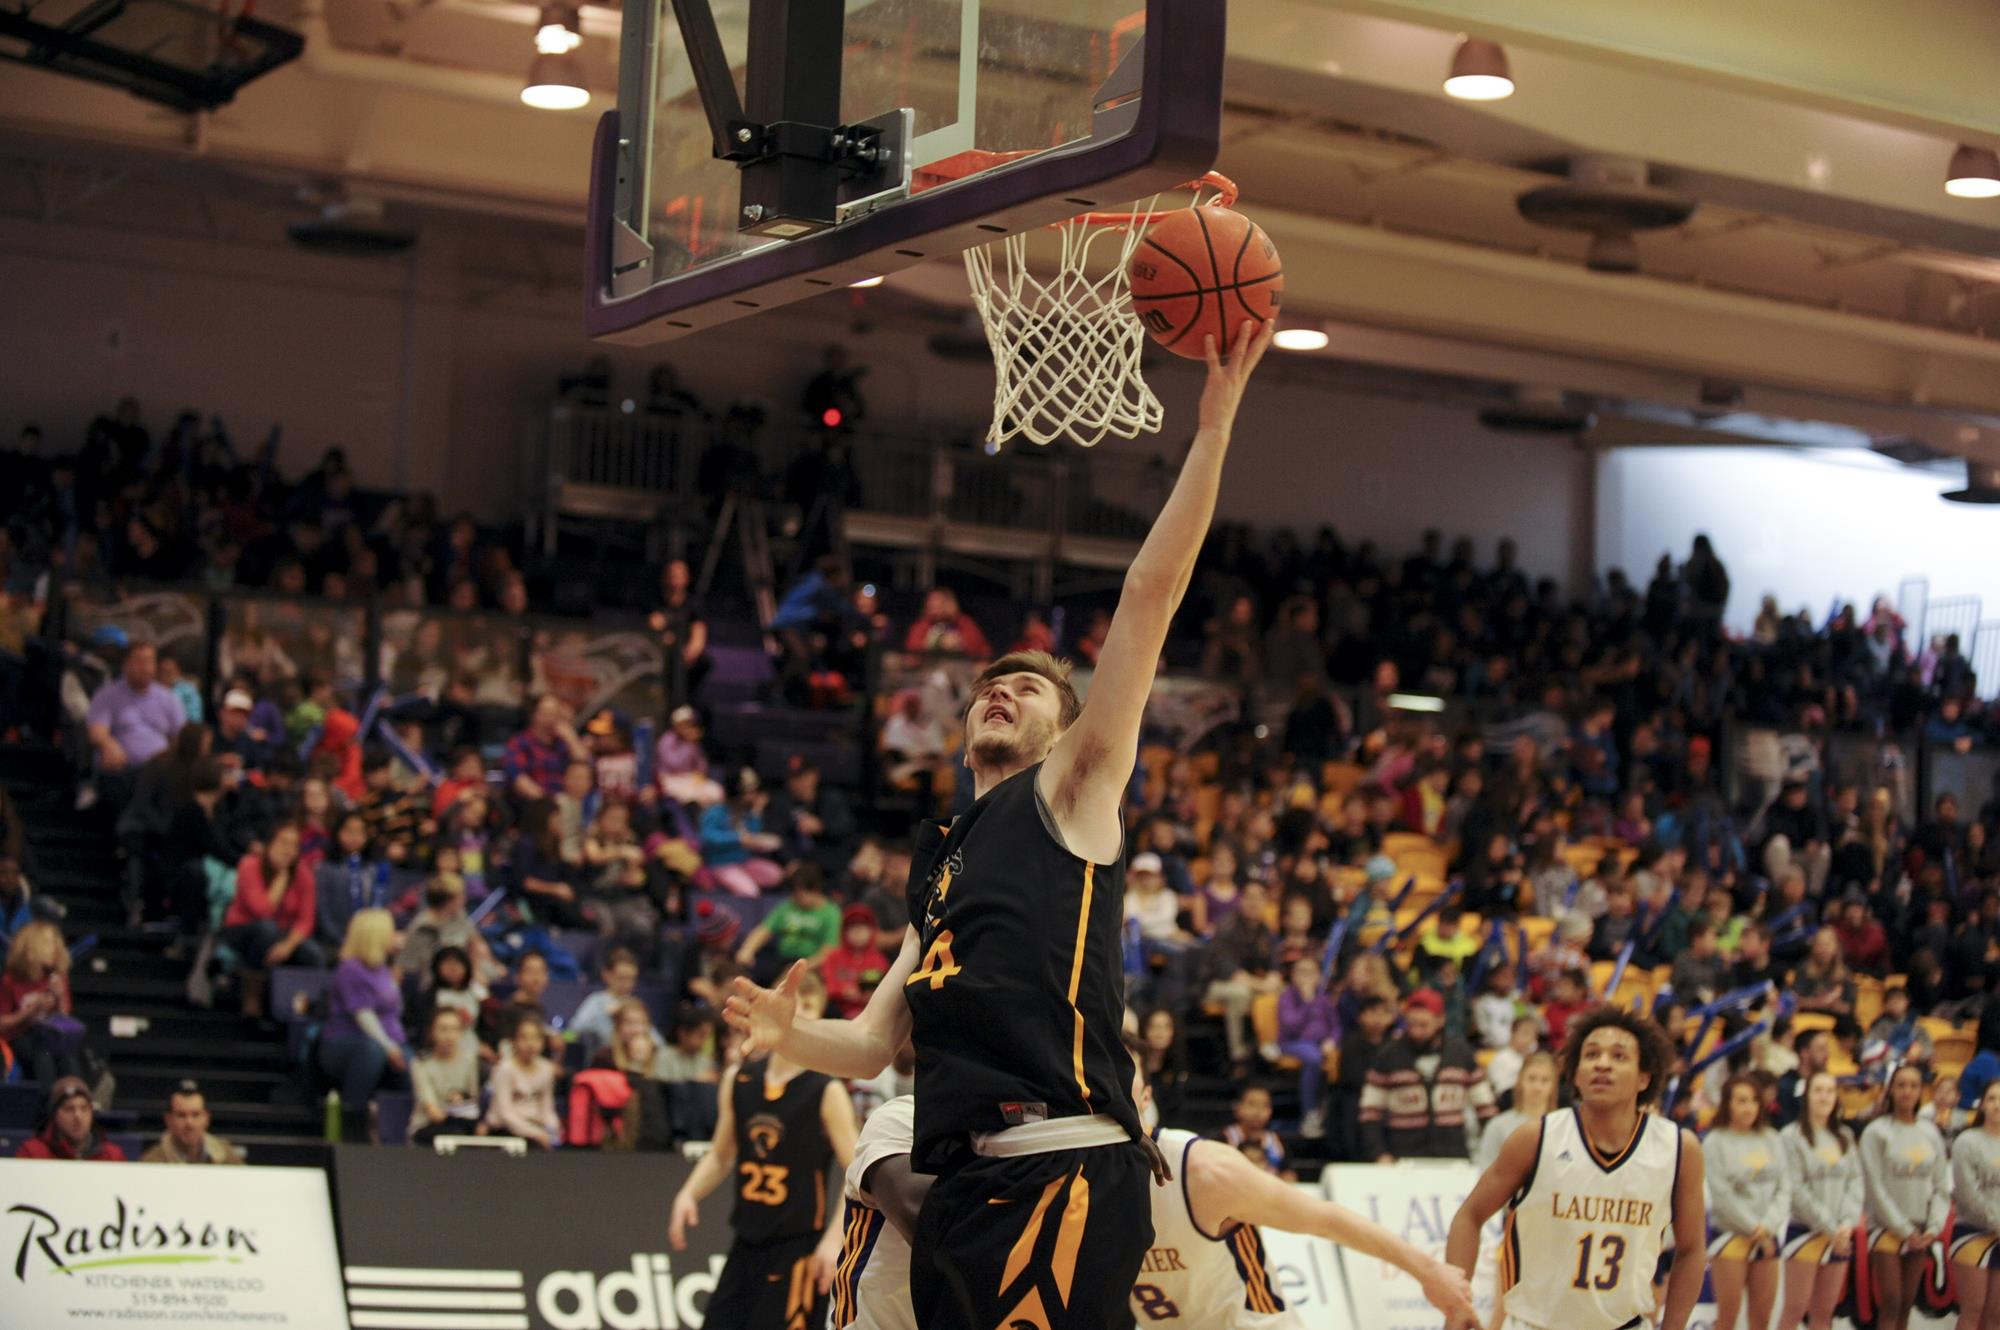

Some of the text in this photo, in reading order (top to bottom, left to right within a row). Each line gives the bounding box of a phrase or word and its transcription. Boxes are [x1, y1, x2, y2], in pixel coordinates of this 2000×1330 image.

[906, 929, 963, 991] 4
[740, 1161, 790, 1206] 23
[1552, 1193, 1654, 1227] LAURIER
[7, 1196, 258, 1283] Radisson
[1572, 1232, 1626, 1291] 13
[85, 1275, 264, 1292] KITCHENER WATERLOO
[536, 1253, 727, 1330] adid
